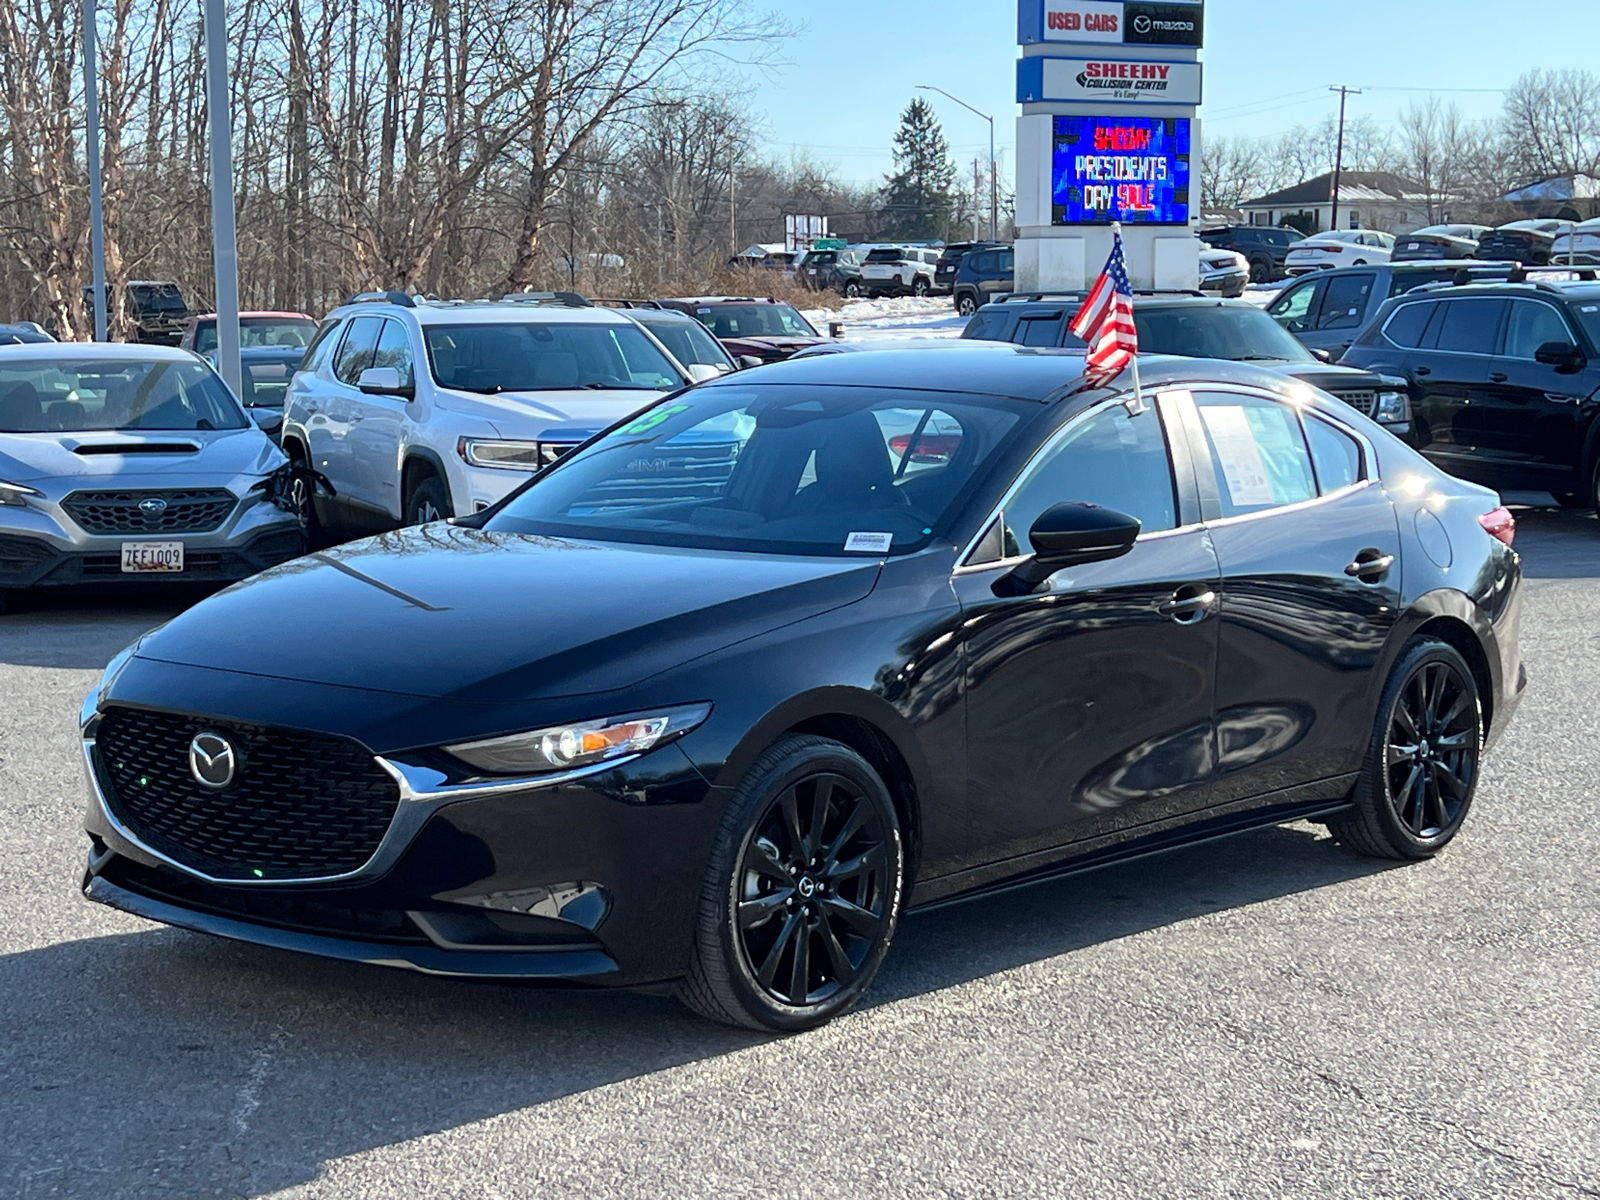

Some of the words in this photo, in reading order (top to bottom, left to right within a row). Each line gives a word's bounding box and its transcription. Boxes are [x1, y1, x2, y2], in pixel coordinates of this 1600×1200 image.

[1048, 12, 1081, 30] USED
[1084, 13, 1118, 32] CARS
[1152, 20, 1194, 31] mazda
[1086, 62, 1170, 79] SHEEHY
[1086, 78, 1133, 89] COLLISION
[1134, 80, 1168, 90] CENTER
[1113, 90, 1123, 98] It's
[1124, 91, 1140, 100] Easy!
[1075, 155, 1167, 180] PRESIDENTS
[1084, 184, 1113, 210] DAY
[1117, 184, 1155, 211] SALE
